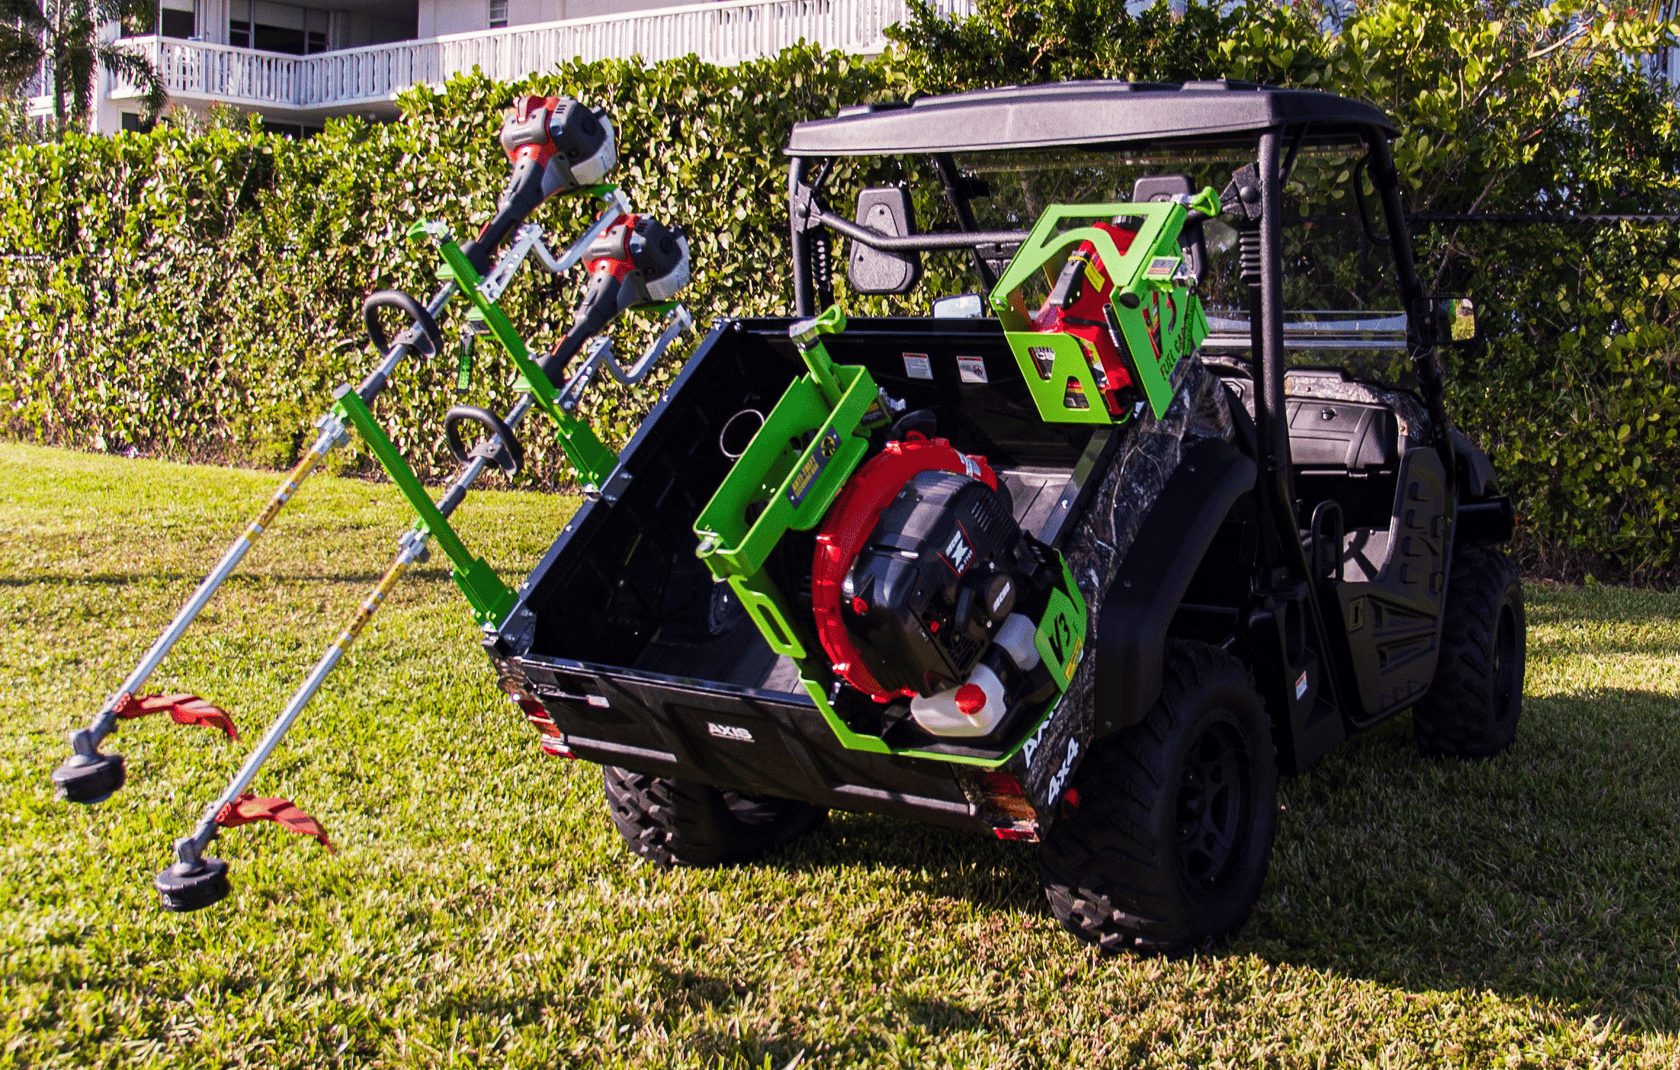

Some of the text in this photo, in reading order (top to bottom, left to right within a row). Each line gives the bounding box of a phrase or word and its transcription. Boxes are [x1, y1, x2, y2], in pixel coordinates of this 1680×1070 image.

[1048, 611, 1071, 668] V3
[708, 722, 753, 740] AXIS
[1047, 737, 1079, 806] 4x4
